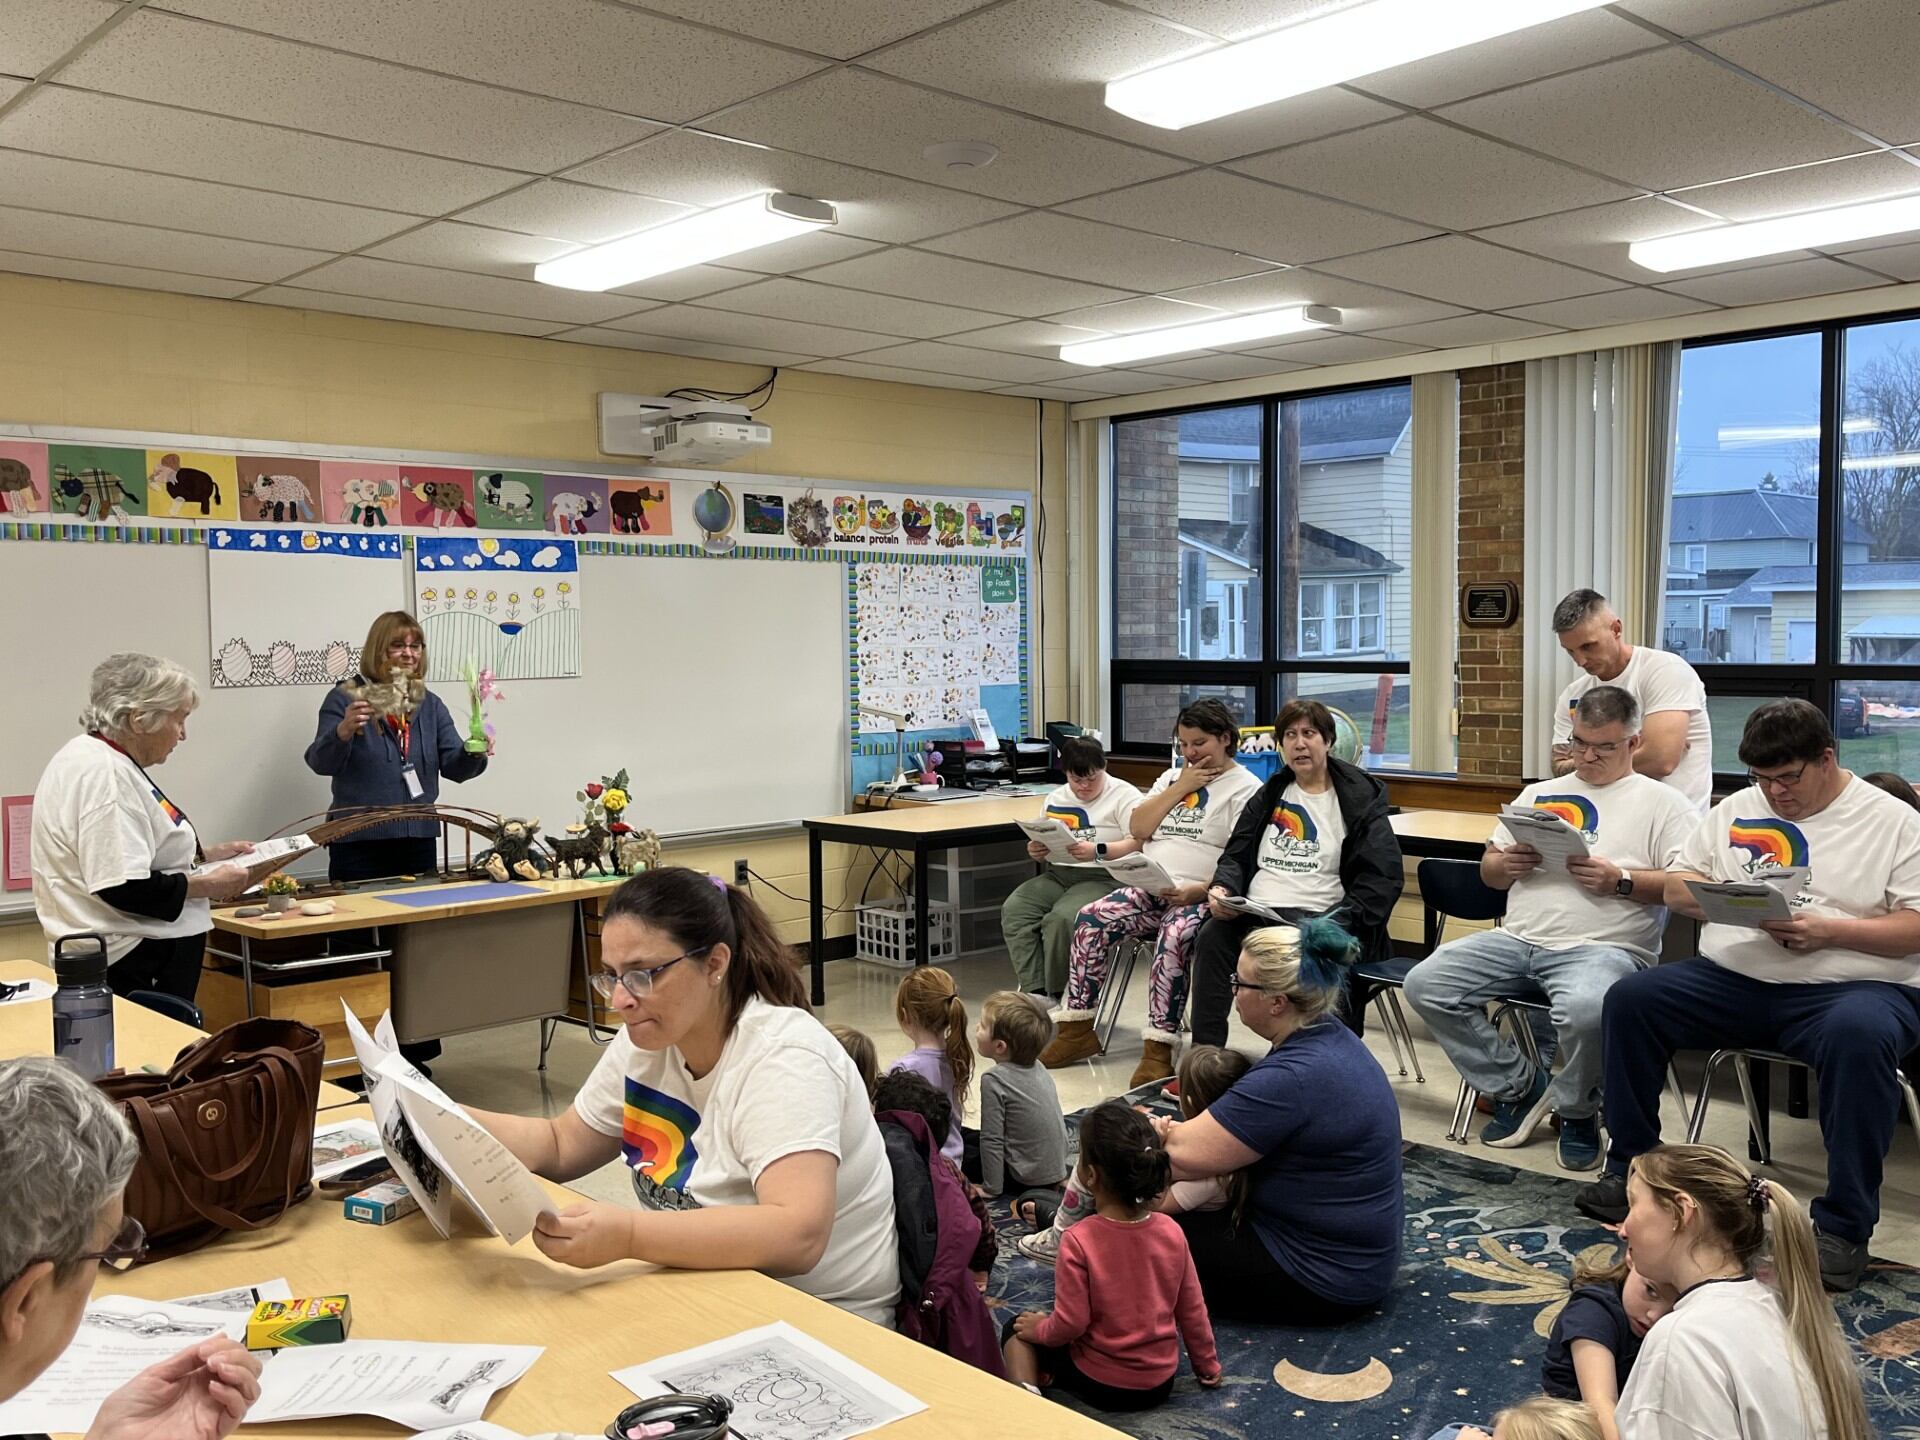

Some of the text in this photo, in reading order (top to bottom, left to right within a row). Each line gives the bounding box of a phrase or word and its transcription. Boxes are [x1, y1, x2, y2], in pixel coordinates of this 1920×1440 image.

[834, 532, 865, 543] balance
[869, 534, 899, 546] protein
[1262, 856, 1284, 866] UPPER
[1284, 860, 1319, 869] MICHIGAN
